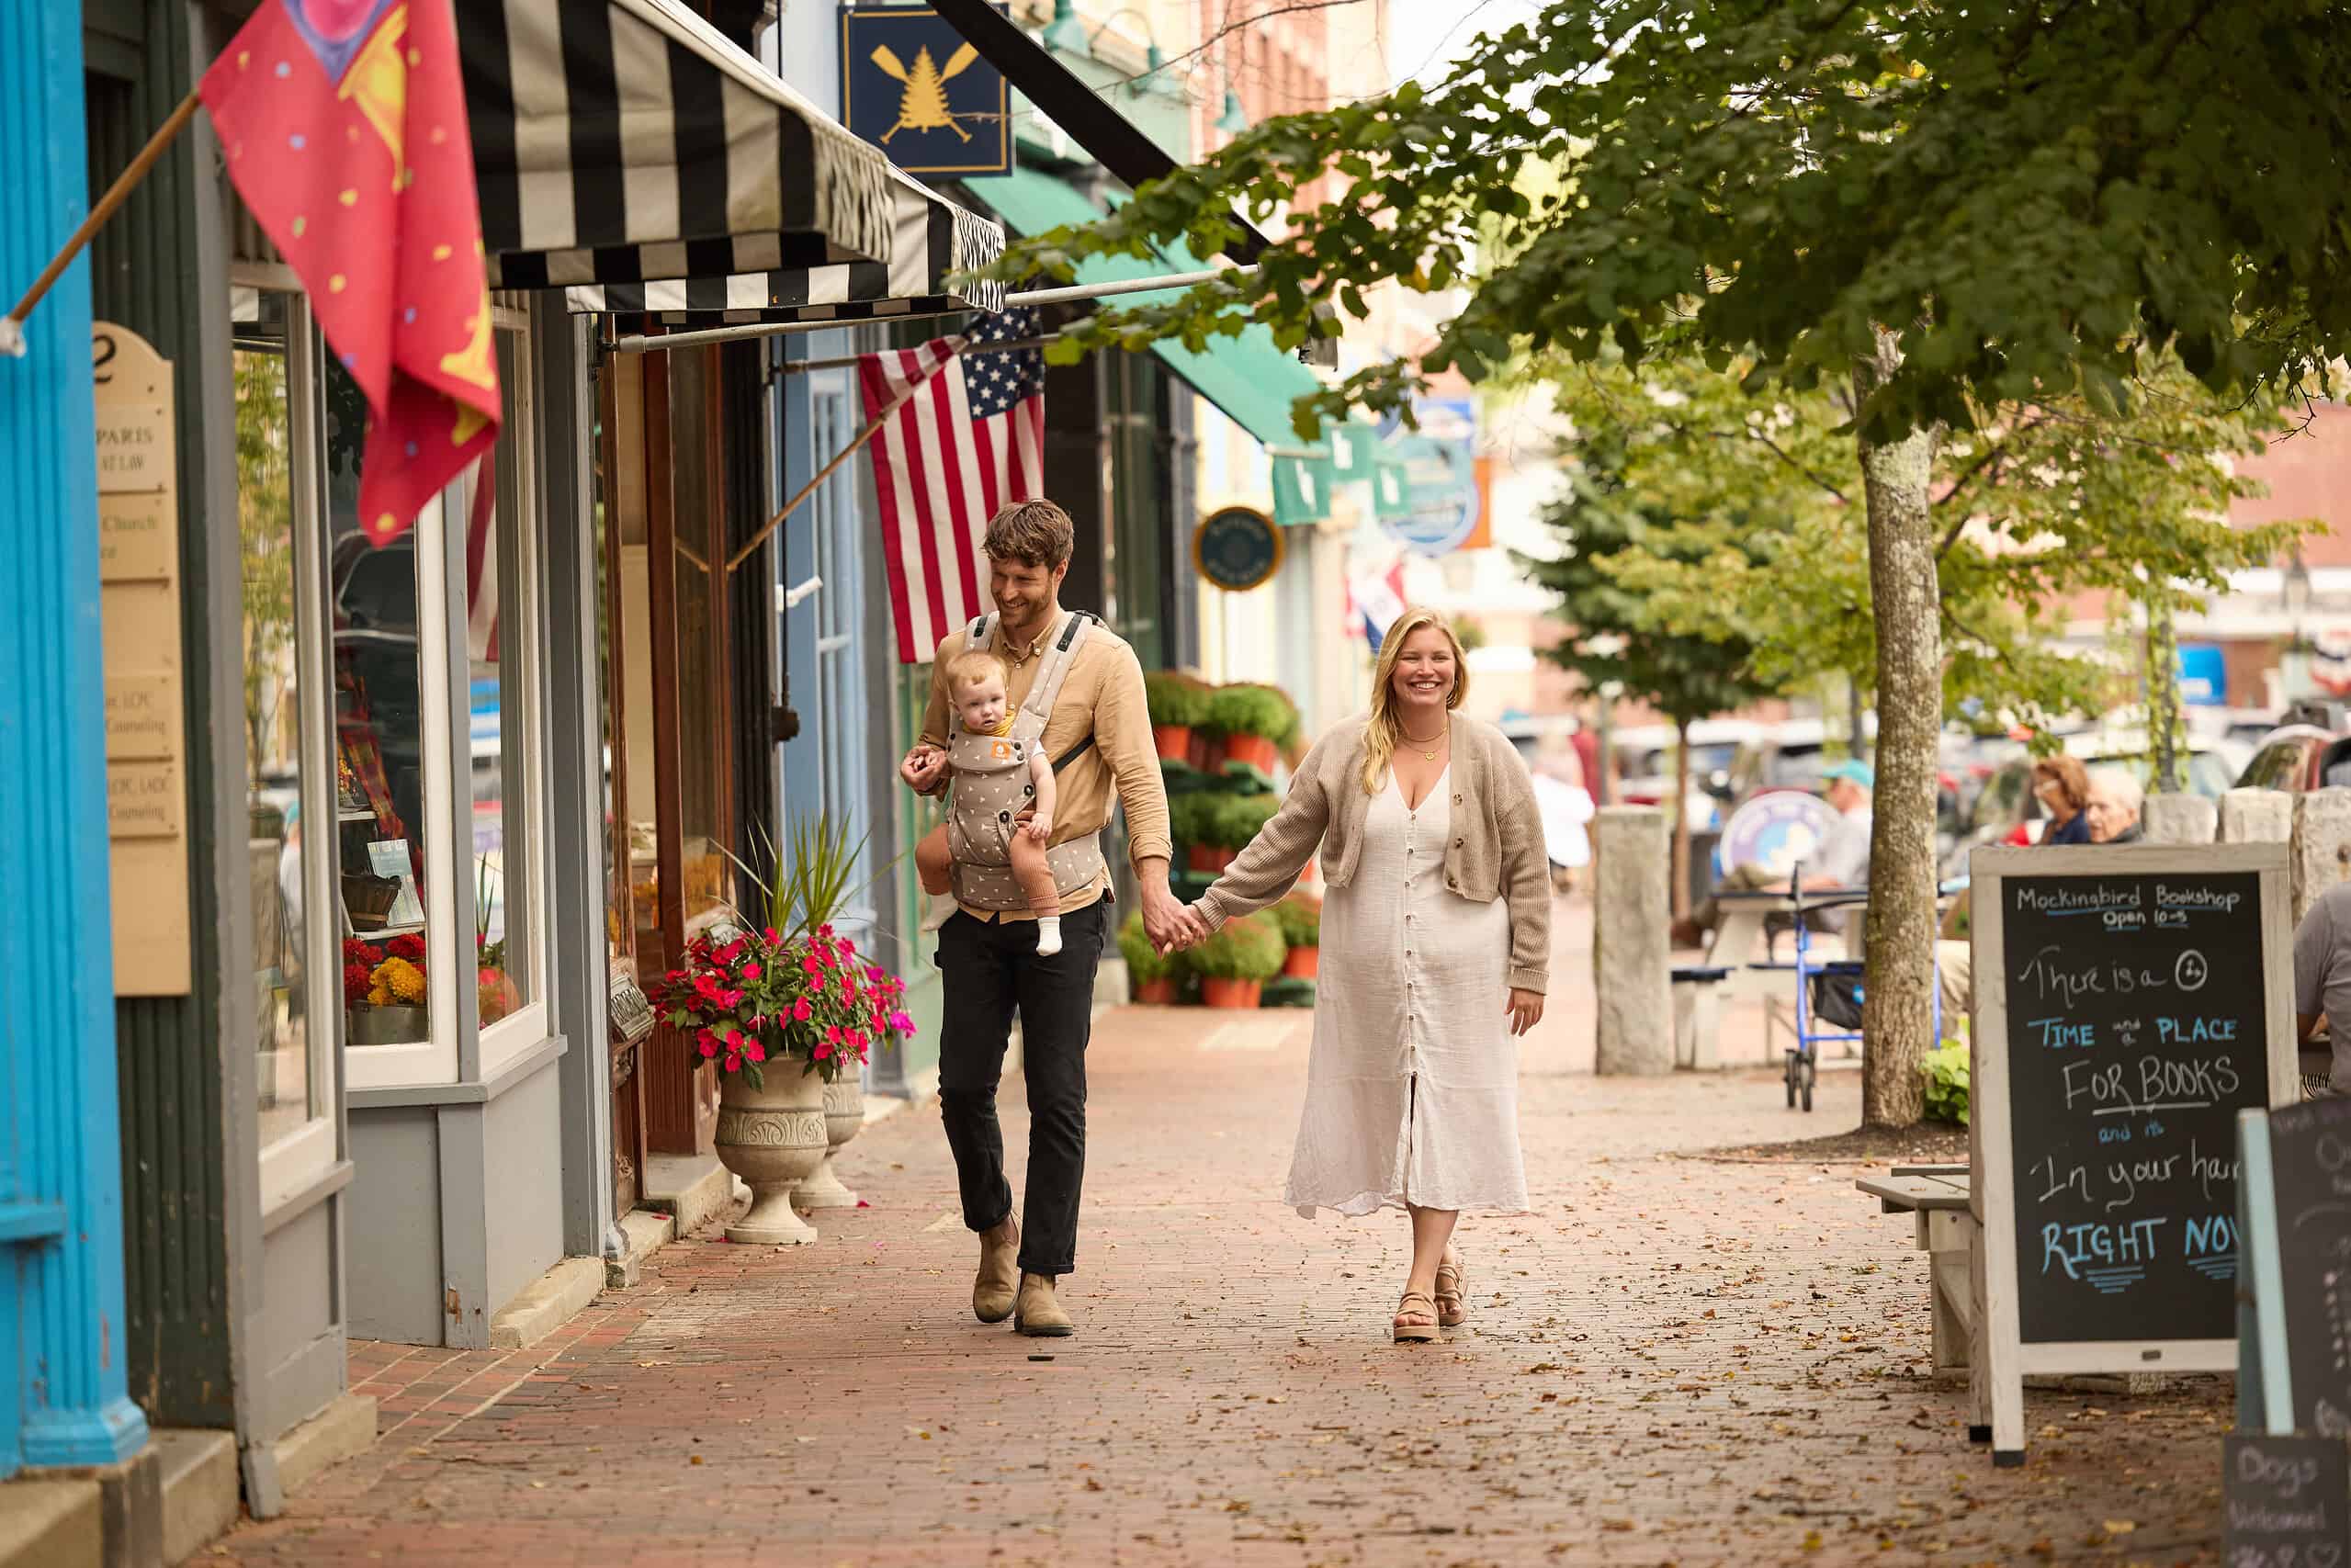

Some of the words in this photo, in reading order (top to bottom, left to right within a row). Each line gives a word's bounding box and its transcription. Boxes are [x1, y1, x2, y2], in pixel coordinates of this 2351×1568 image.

[2018, 885, 2142, 910] Mockingbird
[2156, 885, 2241, 913] Bookshop
[2102, 911, 2146, 930] Open
[2018, 945, 2106, 1009] There
[2112, 961, 2135, 992] is
[2141, 968, 2167, 987] a
[2027, 1017, 2096, 1047] TIME
[2112, 1018, 2142, 1031] and
[2155, 1016, 2239, 1044] PLACE
[2063, 1060, 2136, 1115] FOR
[2140, 1055, 2240, 1103] BOOKS
[2098, 1122, 2132, 1143] and
[2029, 1155, 2093, 1202] In
[2105, 1153, 2182, 1213] your
[2041, 1216, 2169, 1280] RIGHT
[2237, 1445, 2319, 1499] Dogs
